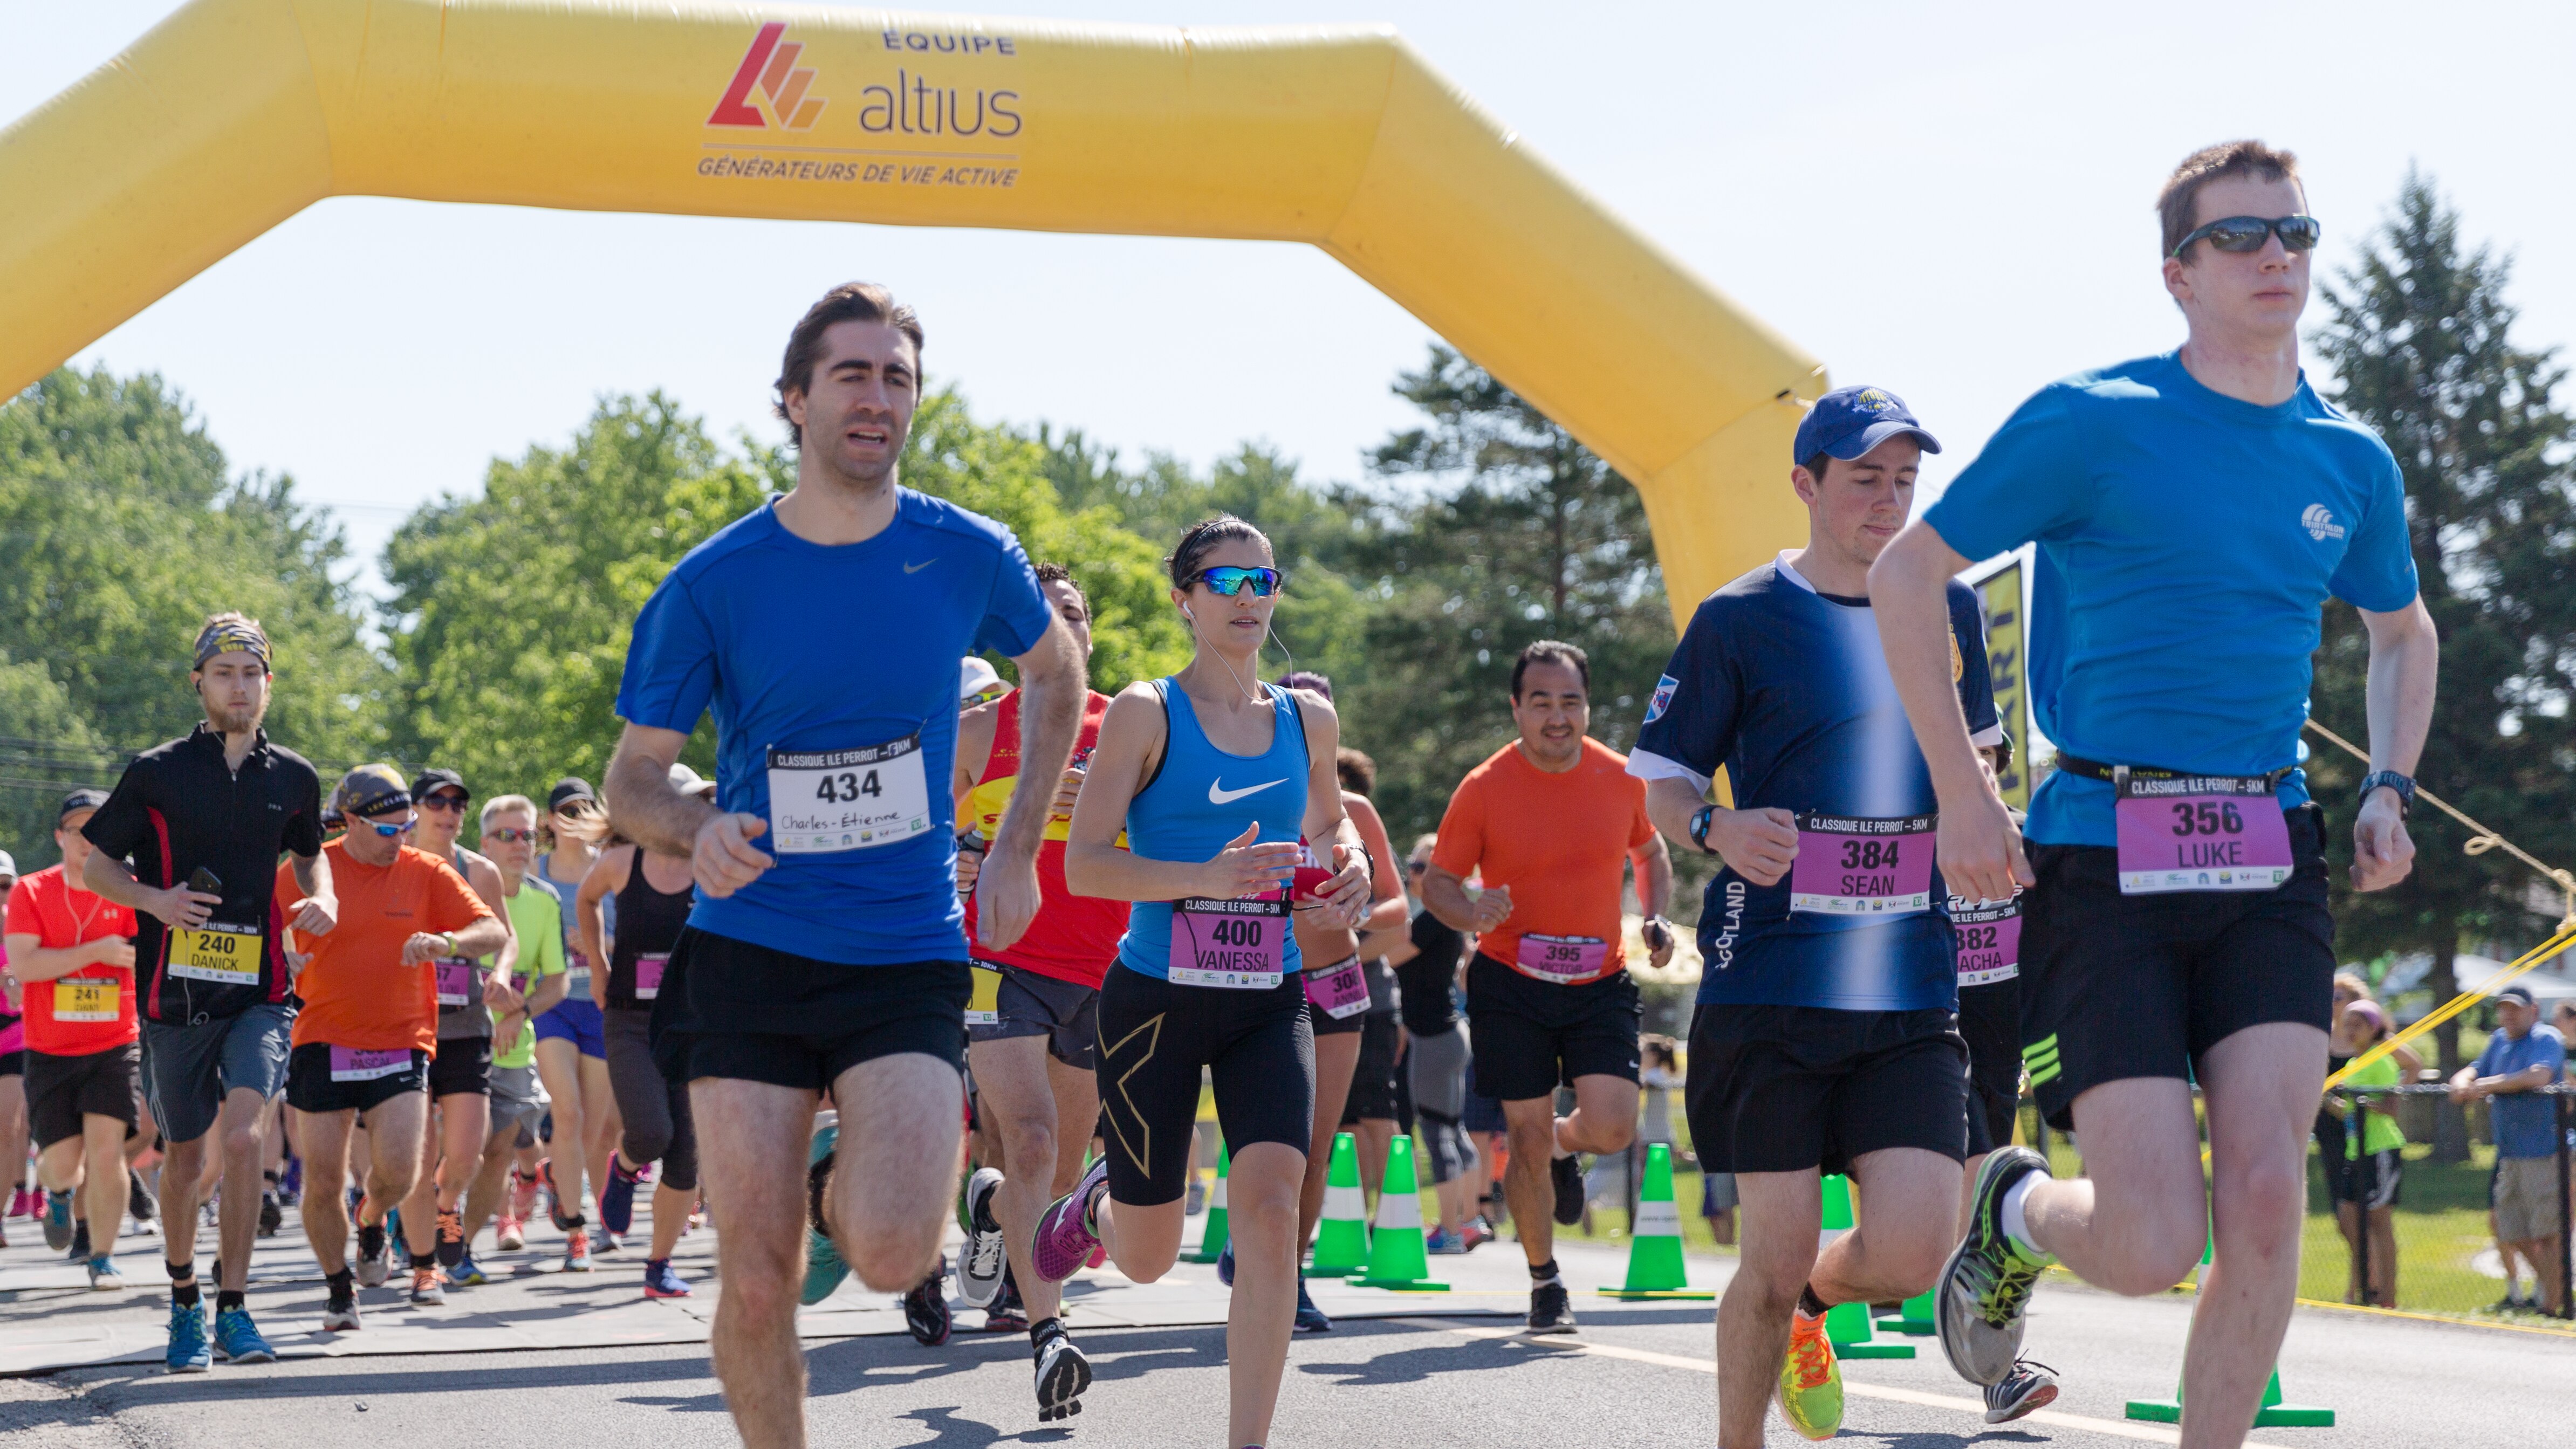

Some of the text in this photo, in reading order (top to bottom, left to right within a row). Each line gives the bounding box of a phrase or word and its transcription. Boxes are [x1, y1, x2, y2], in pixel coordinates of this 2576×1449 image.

[859, 67, 1023, 138] altius
[697, 154, 1019, 188] GÉNÉRATEURS DE VIE ACTIVE
[2301, 519, 2345, 534] TRIATHLON
[777, 754, 825, 767] CLASSIQUE
[827, 754, 842, 766] ILE
[843, 748, 878, 764] PERROT
[817, 769, 882, 804] 434
[2132, 780, 2187, 794] CLASSIQUE
[2189, 779, 2204, 792] ILE
[2205, 778, 2237, 793] PERROT
[2246, 780, 2264, 793] 5KM
[1811, 818, 1858, 832] CLASSIQUE
[1860, 821, 1873, 832] ILE
[1874, 821, 1903, 832] PERROT
[1913, 819, 1928, 830] 5KM
[2171, 801, 2244, 836] 356
[1841, 840, 1899, 869] 384
[2177, 841, 2243, 868] LUKE
[1841, 875, 1895, 896] SEAN
[1185, 900, 1226, 911] CLASSIQUE
[1228, 902, 1238, 911] ILE
[1240, 902, 1265, 913] PERROT
[1270, 904, 1280, 914] 5KM
[1962, 914, 1972, 922] ILE
[1973, 911, 1998, 922] PERROT
[2004, 907, 2016, 917] 5KM
[1212, 919, 1262, 947] 400
[198, 934, 236, 954] 240
[1546, 945, 1581, 962] 395
[191, 953, 239, 971] DANICK
[981, 961, 997, 971] 10KM
[1195, 950, 1269, 971] VANESSA
[1958, 952, 2003, 971] ACHA
